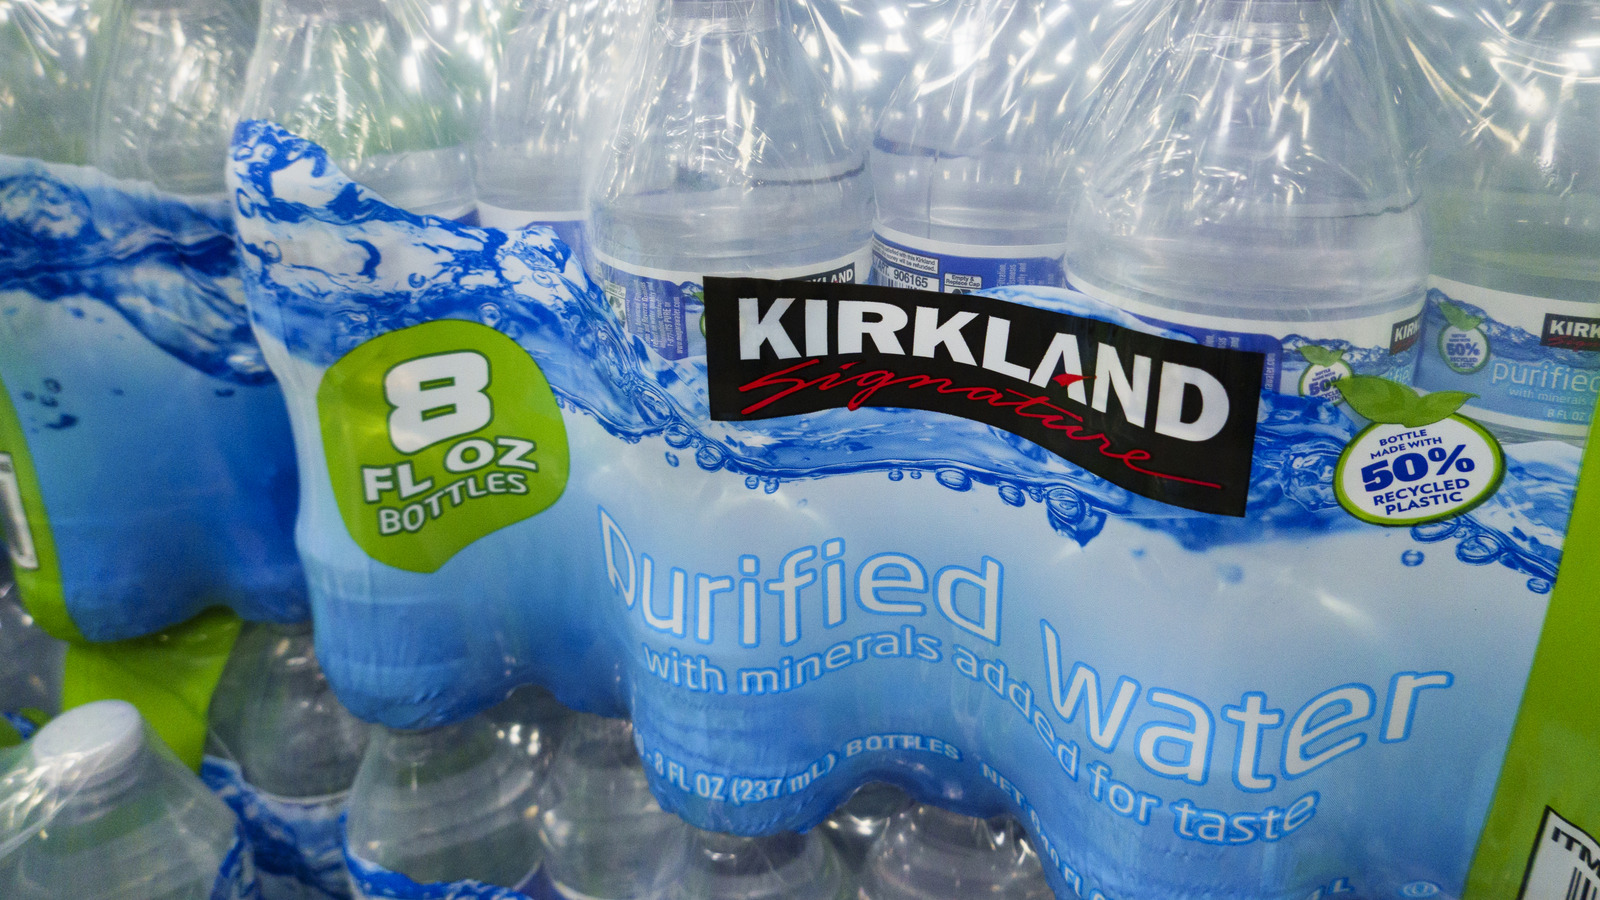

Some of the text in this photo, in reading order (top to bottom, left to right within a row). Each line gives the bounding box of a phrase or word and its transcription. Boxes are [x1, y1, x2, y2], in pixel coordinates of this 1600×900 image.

[893, 269, 929, 288] 906165
[916, 256, 936, 266] Kirkland
[951, 274, 969, 282] Empty
[945, 278, 968, 287] Replace
[1446, 342, 1480, 356] 50%
[738, 297, 1230, 442] KIRKLAND
[384, 350, 492, 455] 8
[738, 359, 1221, 489] Signature
[1379, 429, 1428, 447] BOTTLE
[1370, 436, 1443, 460] MADE WITH
[362, 435, 539, 504] FL OZ
[1361, 444, 1475, 492] 50%
[378, 472, 528, 536] BOTTLES
[1373, 478, 1470, 506] RECYCLED
[1385, 491, 1464, 515] PLASTIC
[1043, 621, 1452, 791] water
[643, 627, 1316, 844] with minerals added for taste
[669, 761, 691, 791] FL
[696, 773, 726, 801] OZ
[731, 777, 783, 806] (237
[790, 752, 836, 794] mL)
[846, 734, 960, 760] BOTTLES
